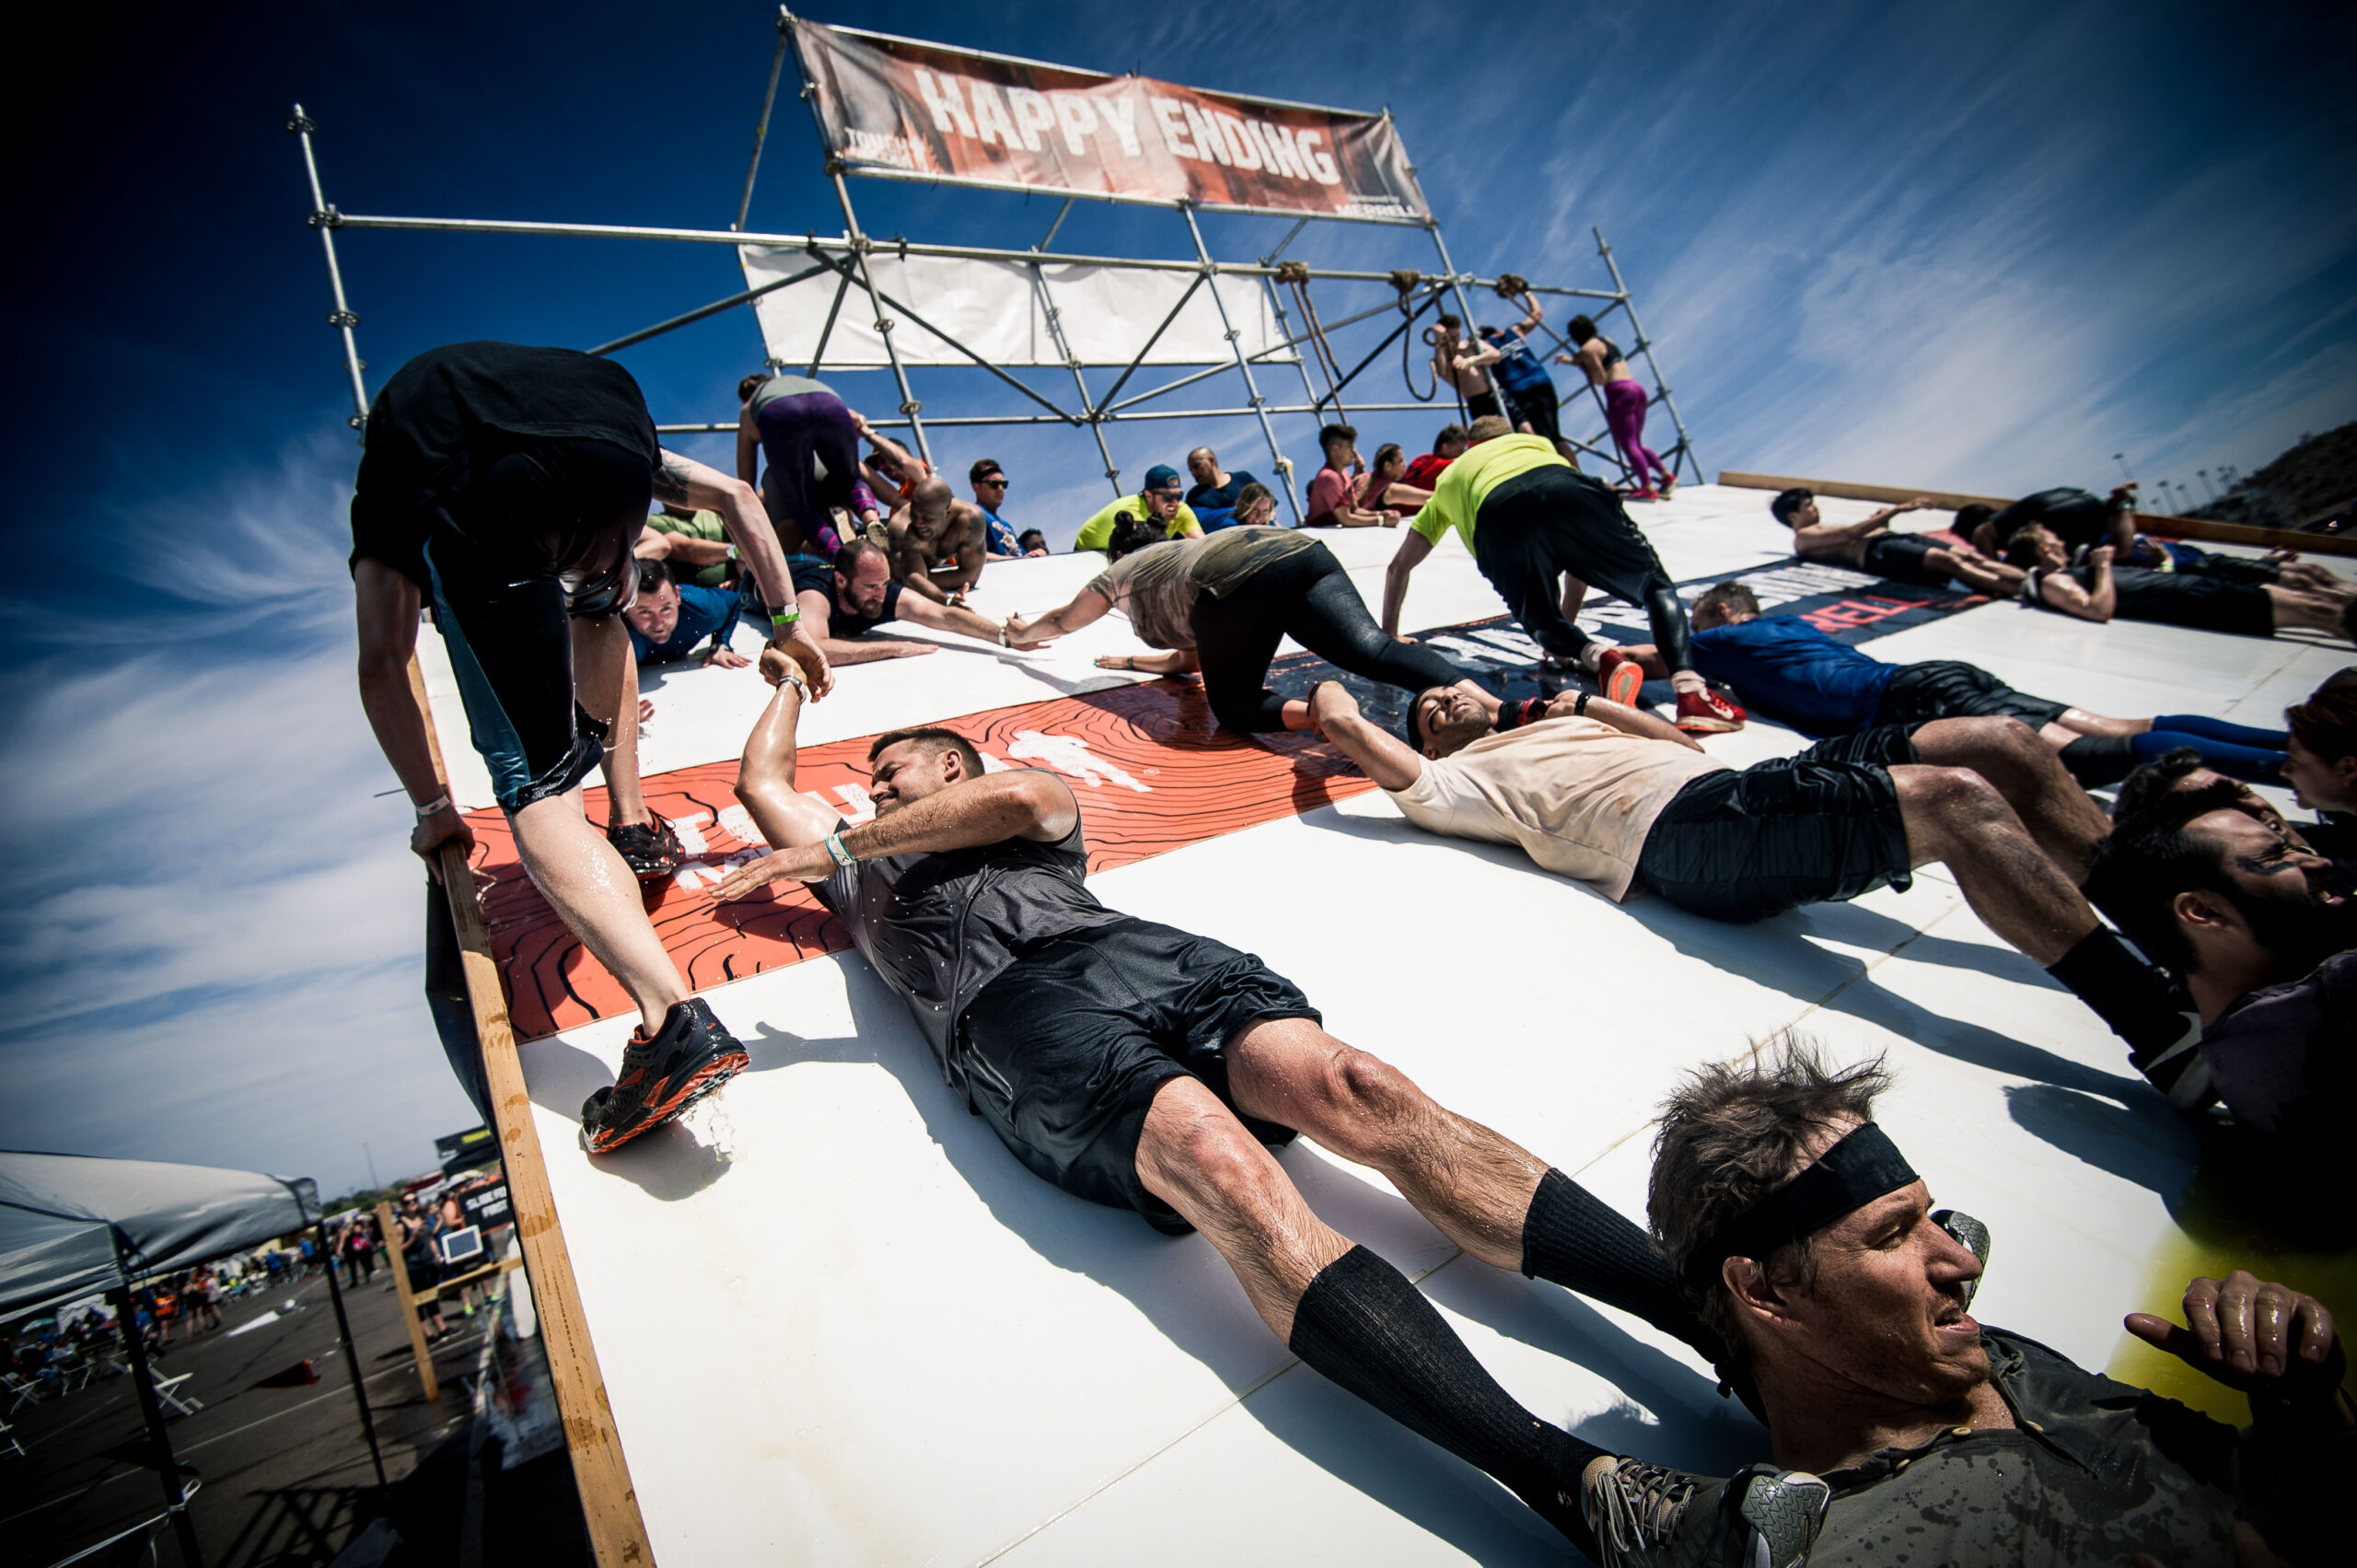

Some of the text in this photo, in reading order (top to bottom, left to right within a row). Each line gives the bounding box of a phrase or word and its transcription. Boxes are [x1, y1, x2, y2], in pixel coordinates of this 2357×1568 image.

[913, 69, 1341, 185] HAPPY ENDING
[1798, 595, 1932, 633] RELL
